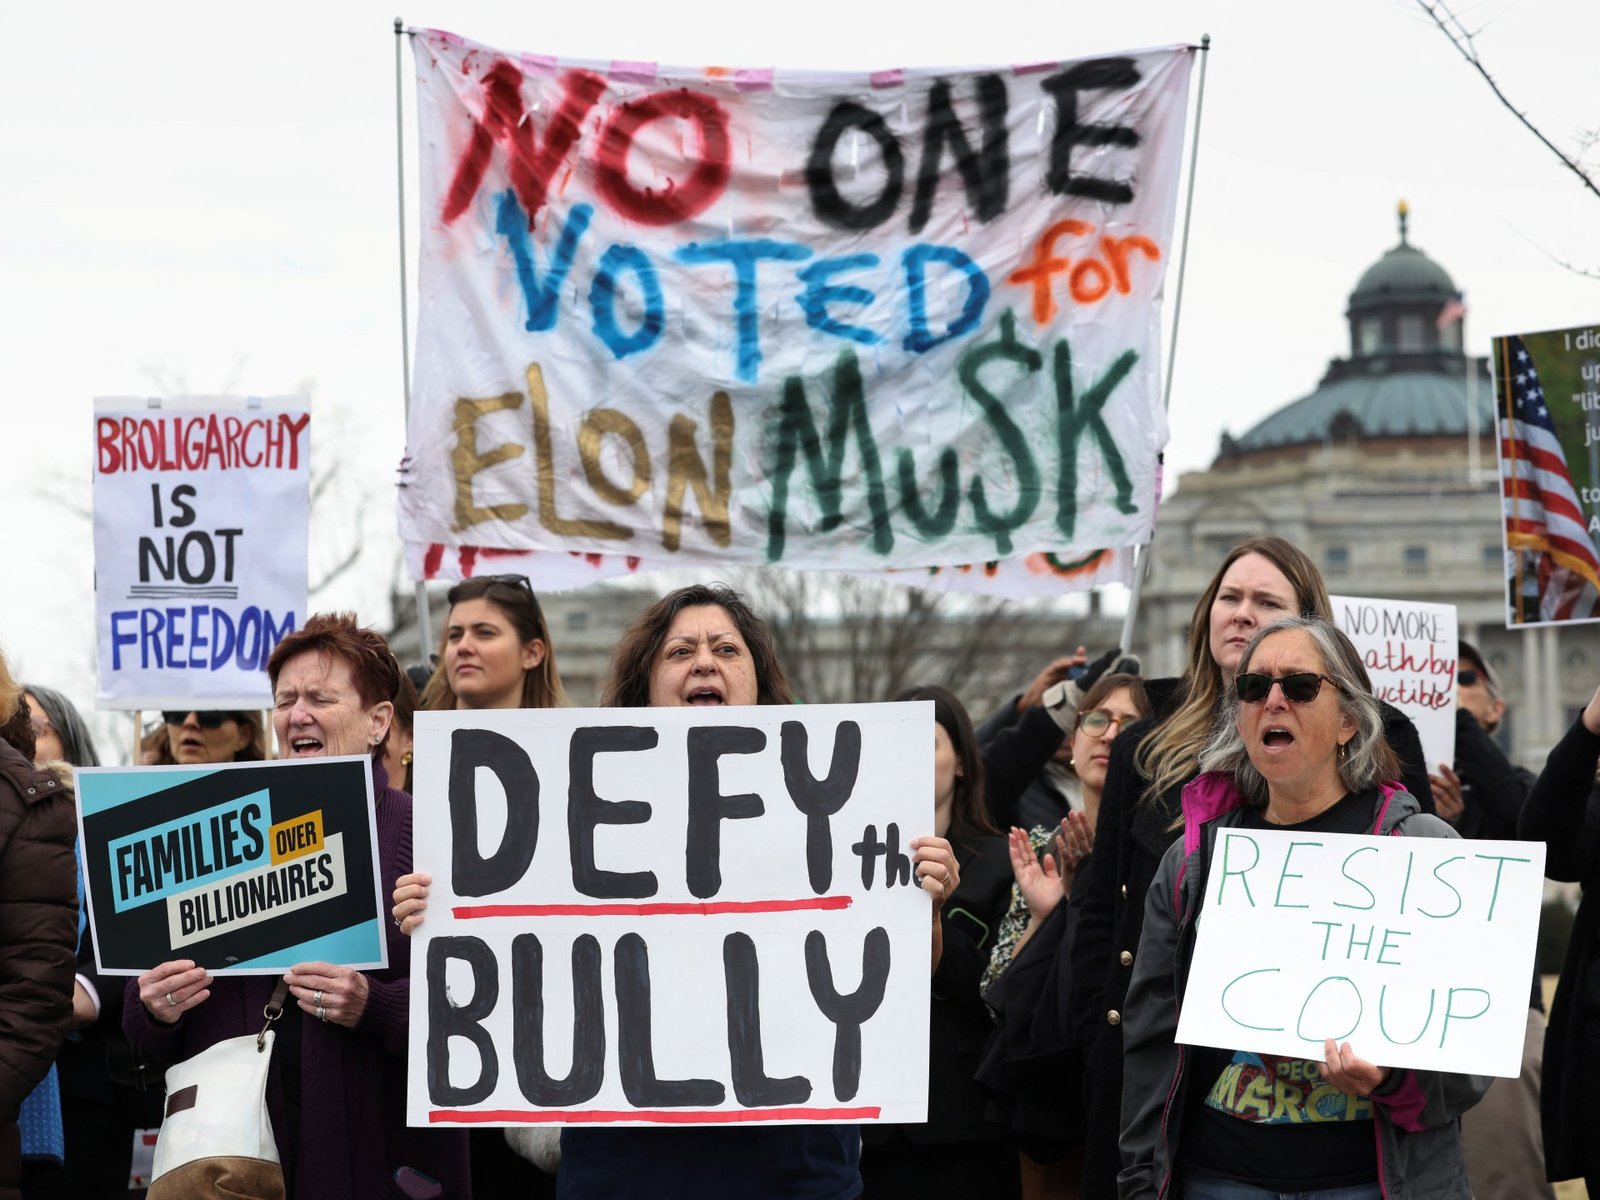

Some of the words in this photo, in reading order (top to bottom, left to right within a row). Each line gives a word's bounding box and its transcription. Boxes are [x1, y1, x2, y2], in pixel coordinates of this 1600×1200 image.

[441, 58, 732, 231] NO
[806, 56, 1142, 234] ONE
[490, 188, 990, 383] VOTED
[1009, 218, 1161, 325] for
[97, 413, 310, 474] BROLIGARCHY
[451, 362, 734, 552] ELON
[151, 484, 197, 528] IS
[138, 528, 243, 584] NOT
[1345, 605, 1378, 635] NO
[1383, 608, 1446, 643] MORE
[1363, 640, 1428, 672] ath
[1375, 680, 1450, 711] uctible
[449, 720, 861, 899] DEFY
[116, 803, 264, 901] FAMILIES
[276, 820, 317, 857] OVER
[1217, 834, 1531, 921] RESIST
[180, 852, 334, 937] BILLIONAIRES
[1312, 921, 1411, 965] THE
[427, 926, 890, 1107] BULLY
[1221, 968, 1491, 1049] COUP
[1275, 1061, 1321, 1082] PEO
